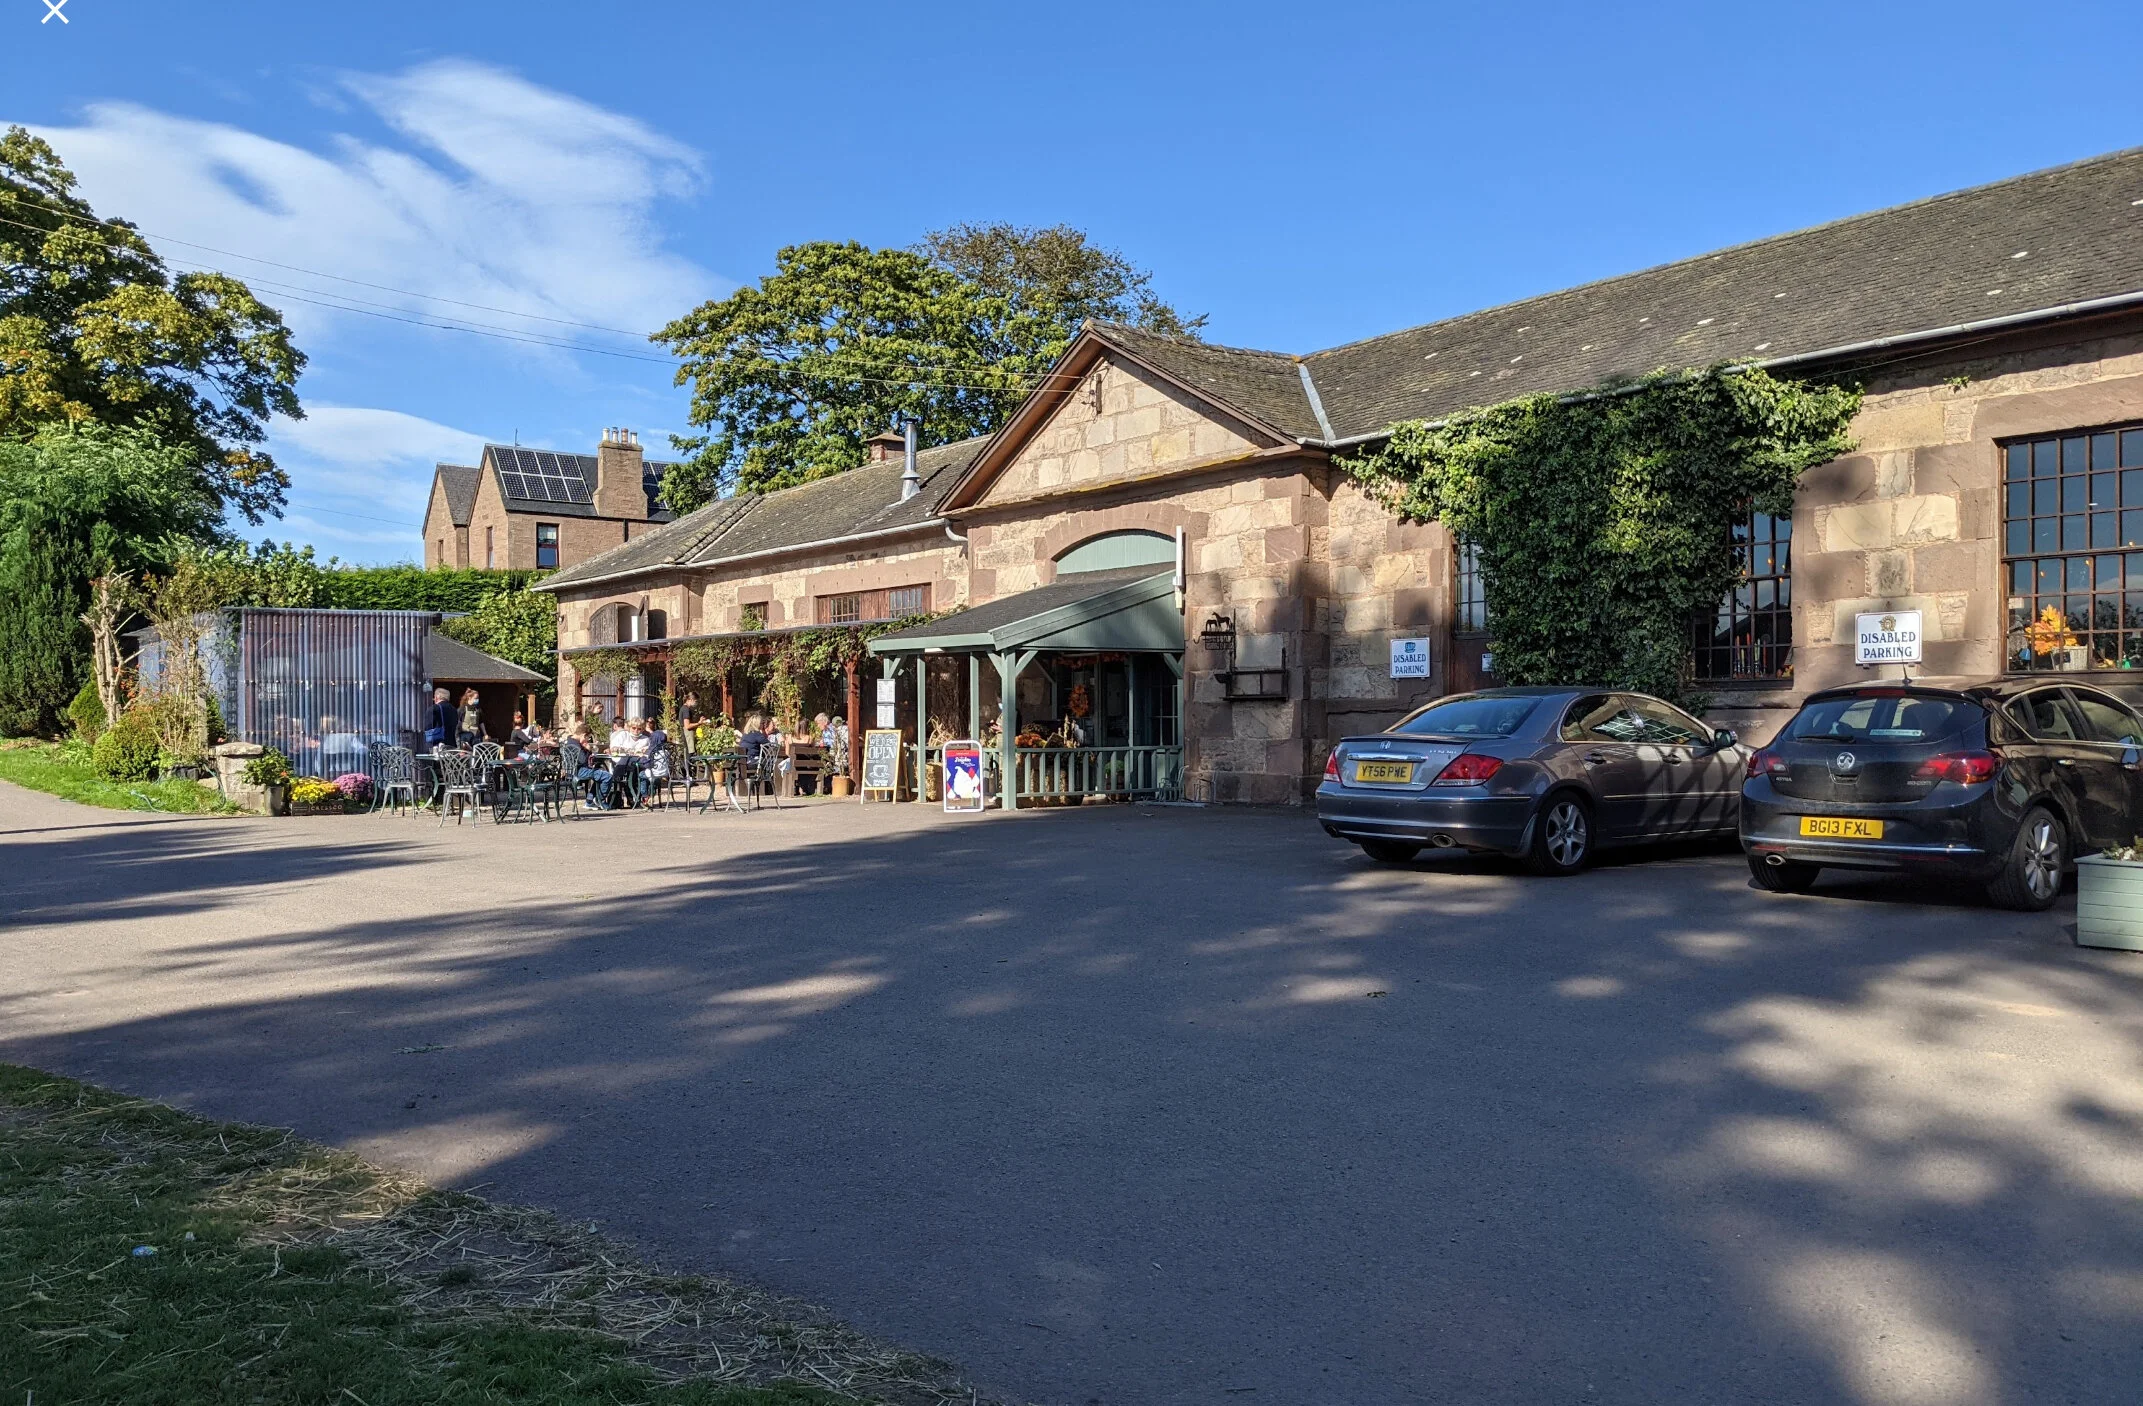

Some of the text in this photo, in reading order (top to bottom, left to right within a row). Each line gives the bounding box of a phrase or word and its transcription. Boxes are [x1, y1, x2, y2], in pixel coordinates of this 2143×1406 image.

[1861, 631, 1916, 643] DISABLED
[1393, 653, 1427, 664] DISABLED
[1863, 646, 1912, 659] PARKING
[1395, 664, 1425, 675] PARKING
[868, 746, 897, 759] OPEN
[1361, 765, 1386, 777] YT56
[1809, 820, 1872, 836] BG13 FXL
